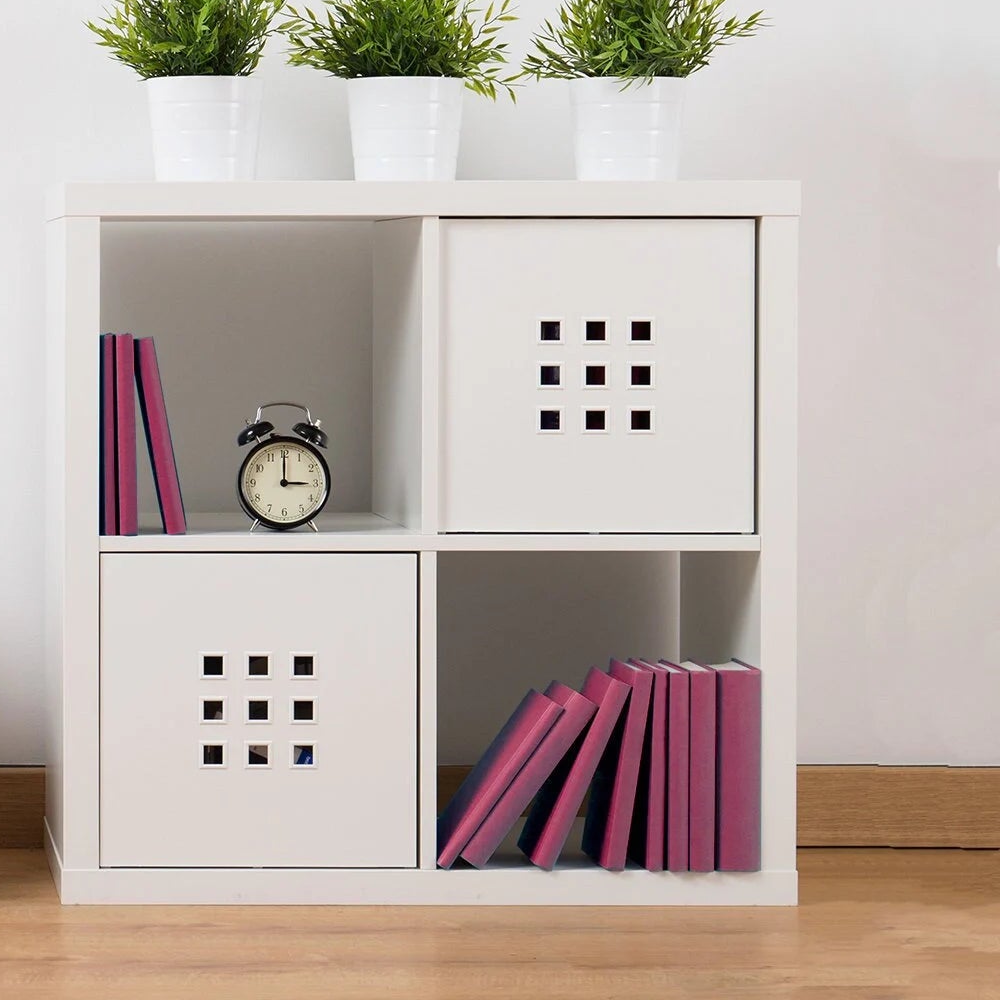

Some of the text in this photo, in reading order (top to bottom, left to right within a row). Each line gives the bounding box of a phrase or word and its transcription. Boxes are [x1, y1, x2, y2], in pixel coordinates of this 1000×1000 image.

[267, 453, 275, 462] 11
[255, 464, 264, 472] 10
[308, 464, 314, 472] 2
[250, 478, 256, 487] 9
[313, 479, 318, 487] 3
[255, 494, 261, 502] 8
[308, 494, 313, 502] 4
[266, 504, 272, 512] 7
[281, 507, 287, 516] 6
[299, 504, 305, 512] 5
